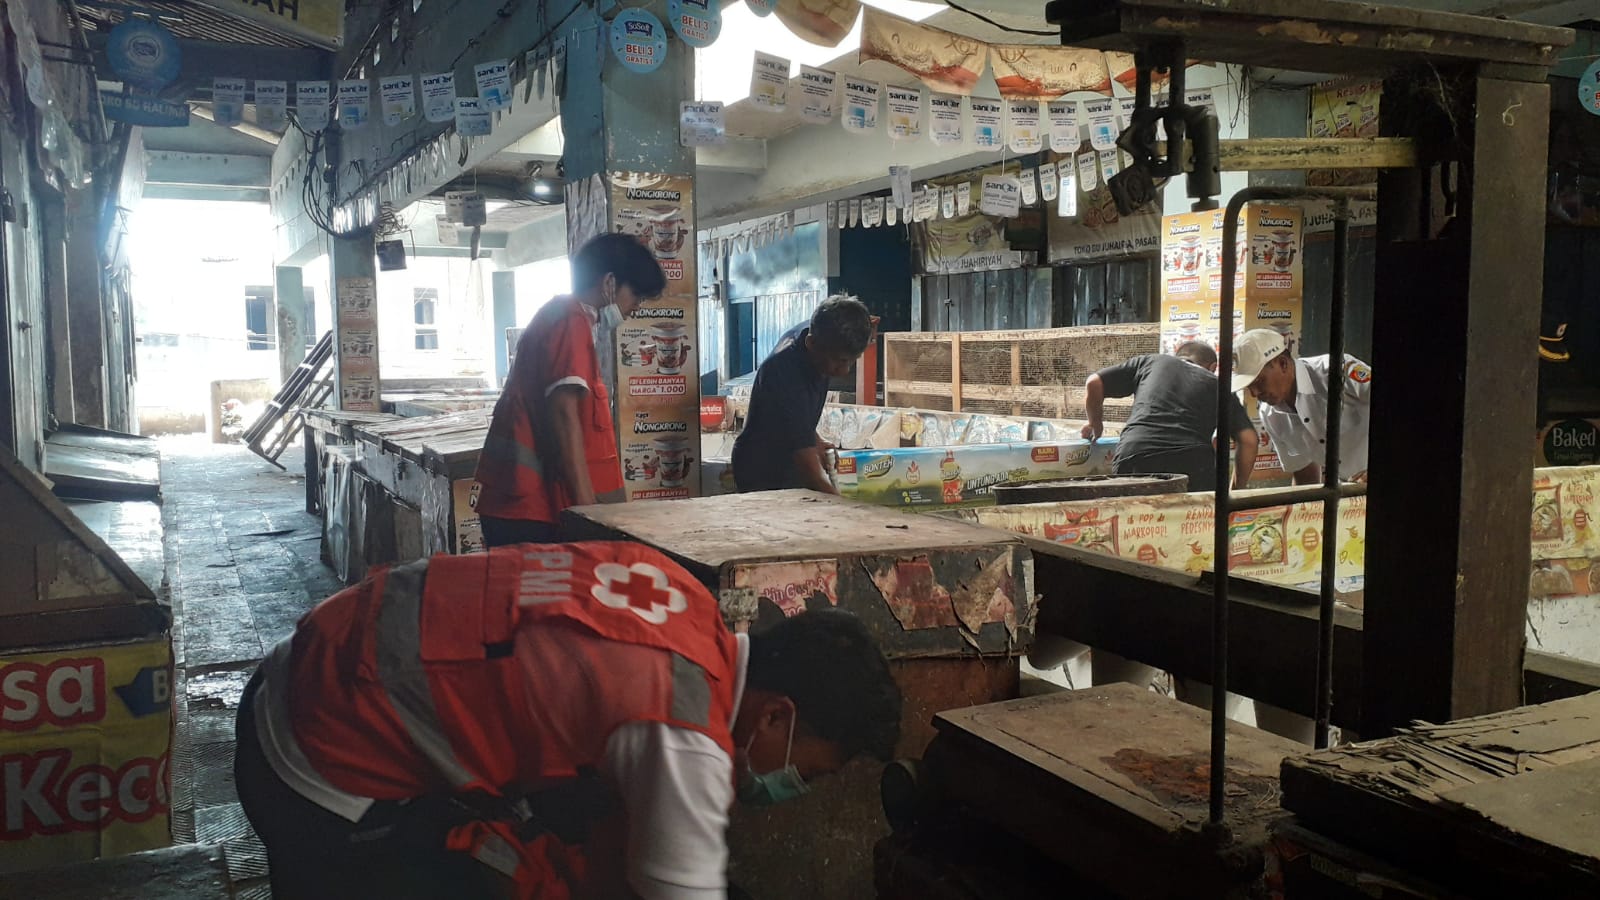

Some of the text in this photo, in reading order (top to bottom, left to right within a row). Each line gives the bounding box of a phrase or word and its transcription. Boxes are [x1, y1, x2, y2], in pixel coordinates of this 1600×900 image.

[682, 16, 709, 31] BELI 3
[681, 28, 705, 40] GRATIS
[626, 44, 653, 56] BELI 3
[625, 56, 649, 64] GRATIS
[101, 95, 122, 108] OKO
[631, 385, 684, 394] HARGA 1.000
[1553, 427, 1596, 449] Baked
[839, 457, 852, 466] ARU
[967, 474, 995, 490] UNTUNG
[1181, 521, 1215, 534] PEDESNY
[518, 551, 573, 606] PMI
[2, 665, 96, 722] sa
